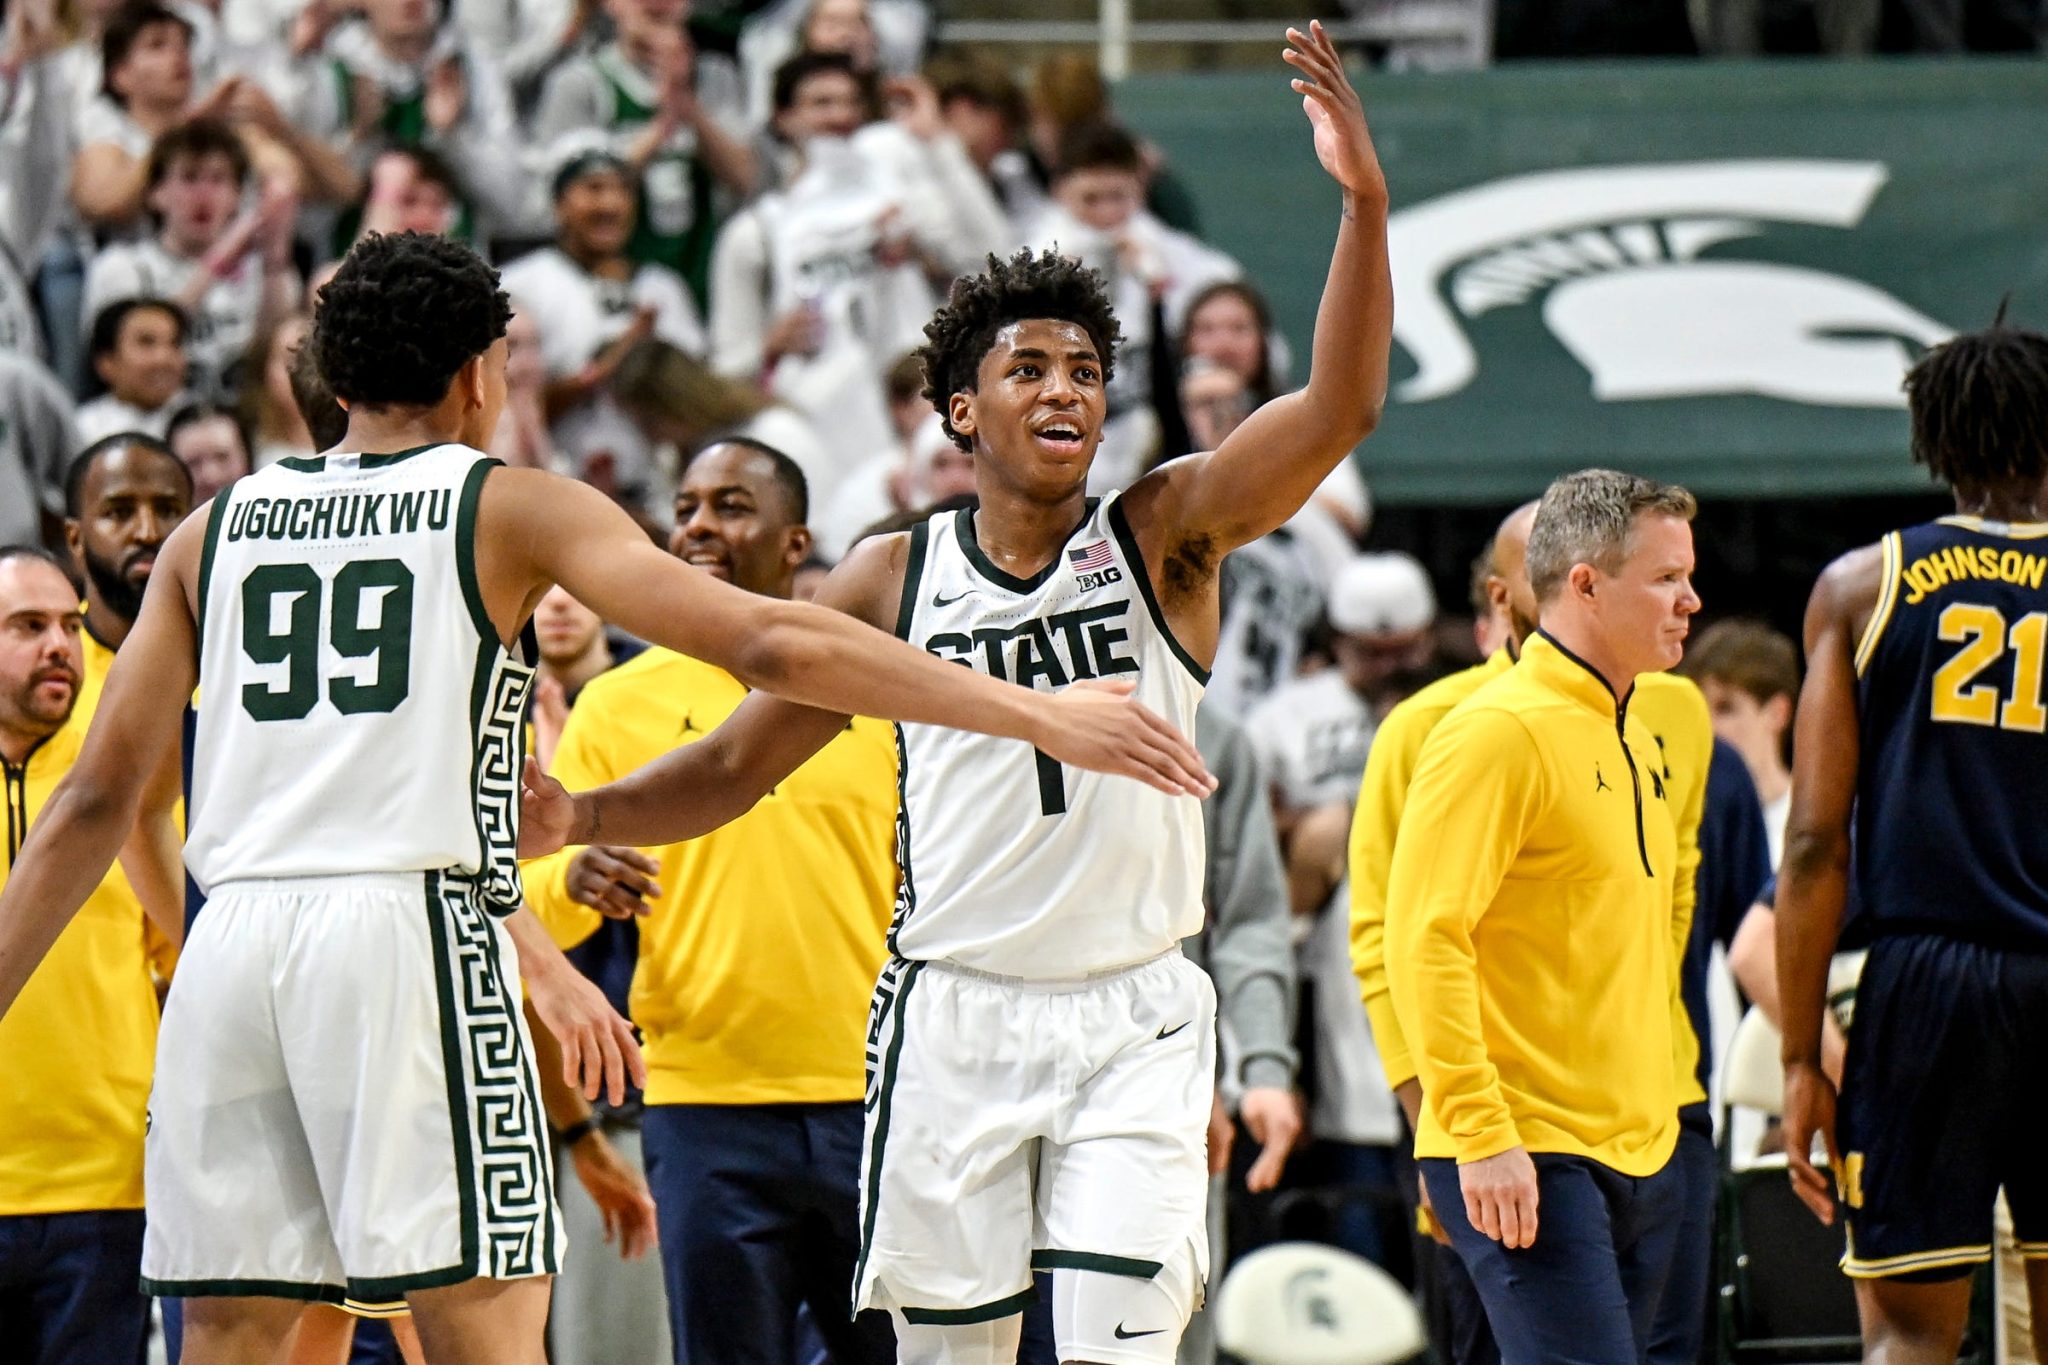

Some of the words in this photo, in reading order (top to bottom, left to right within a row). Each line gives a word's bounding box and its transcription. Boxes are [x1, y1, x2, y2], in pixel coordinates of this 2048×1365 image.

[228, 489, 451, 542] UGOCHUKWU
[1902, 546, 2048, 604] JOHNSON
[242, 559, 414, 722] 99
[1931, 602, 2047, 733] 21
